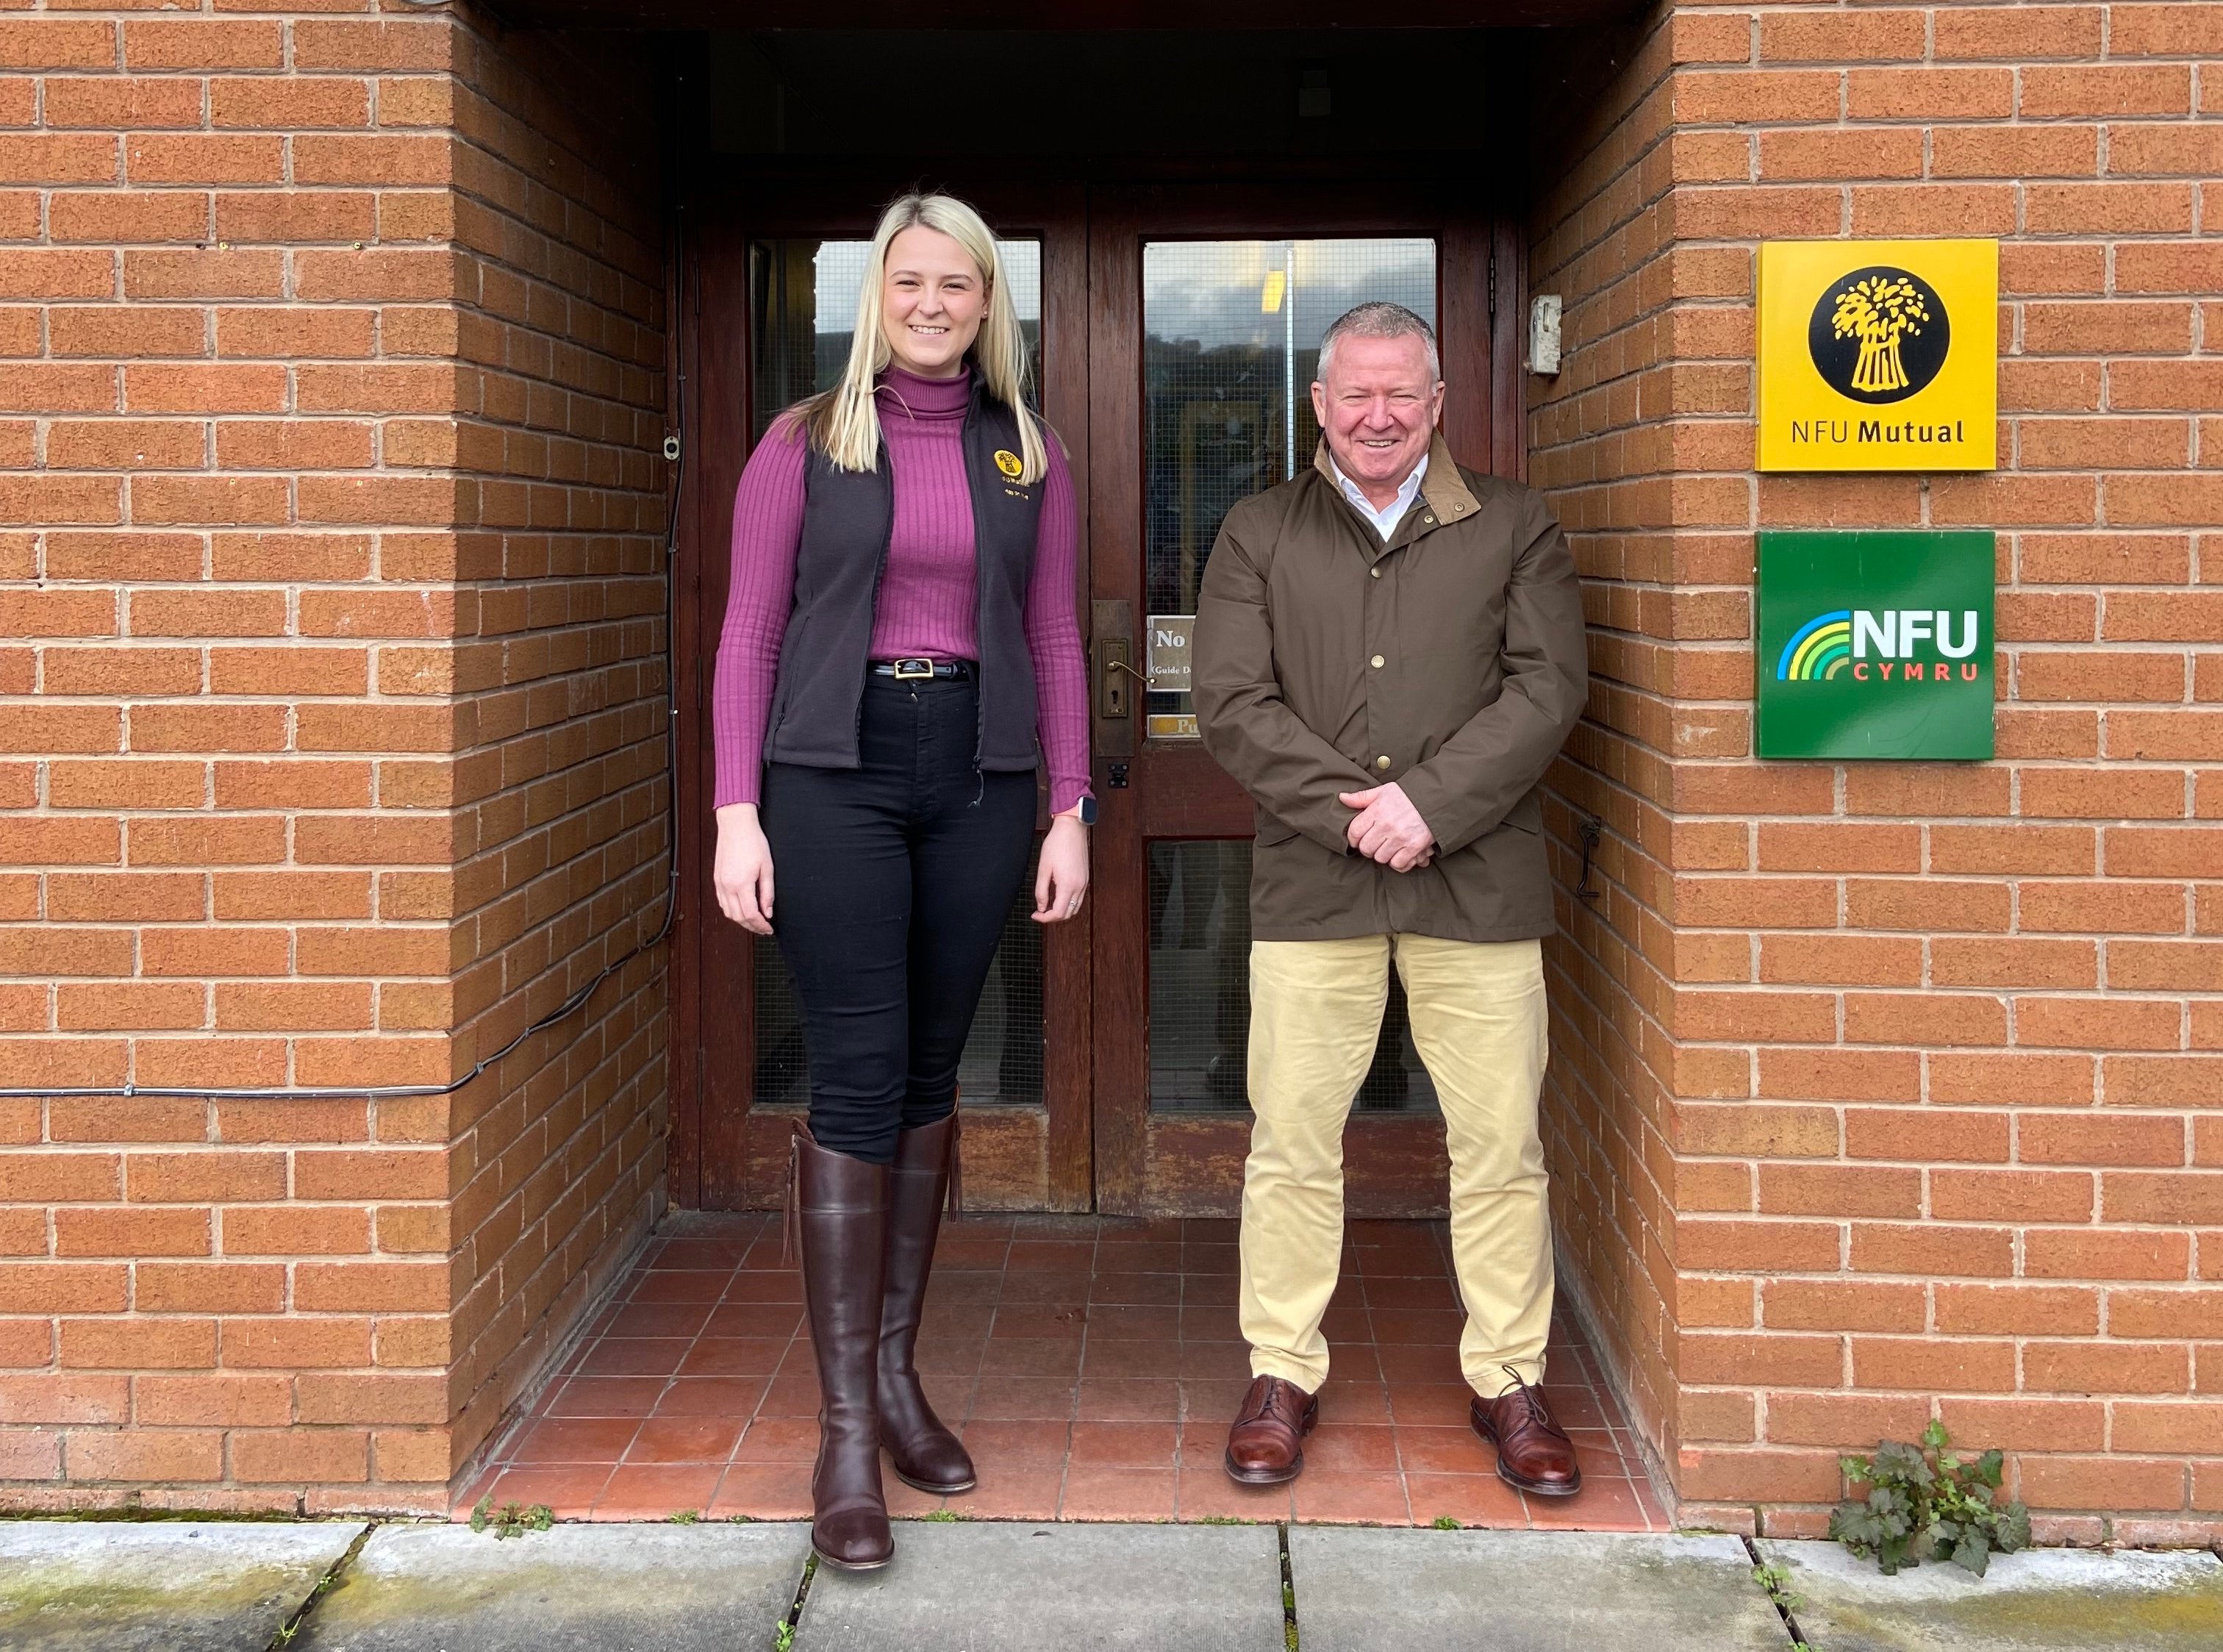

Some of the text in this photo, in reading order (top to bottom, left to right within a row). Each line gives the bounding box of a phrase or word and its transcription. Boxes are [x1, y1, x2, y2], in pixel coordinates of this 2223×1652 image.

[1791, 420, 1964, 443] NFU Mutual
[1156, 630, 1185, 647] No
[1853, 610, 1978, 659] NFU
[1853, 662, 1978, 682] CYMRU
